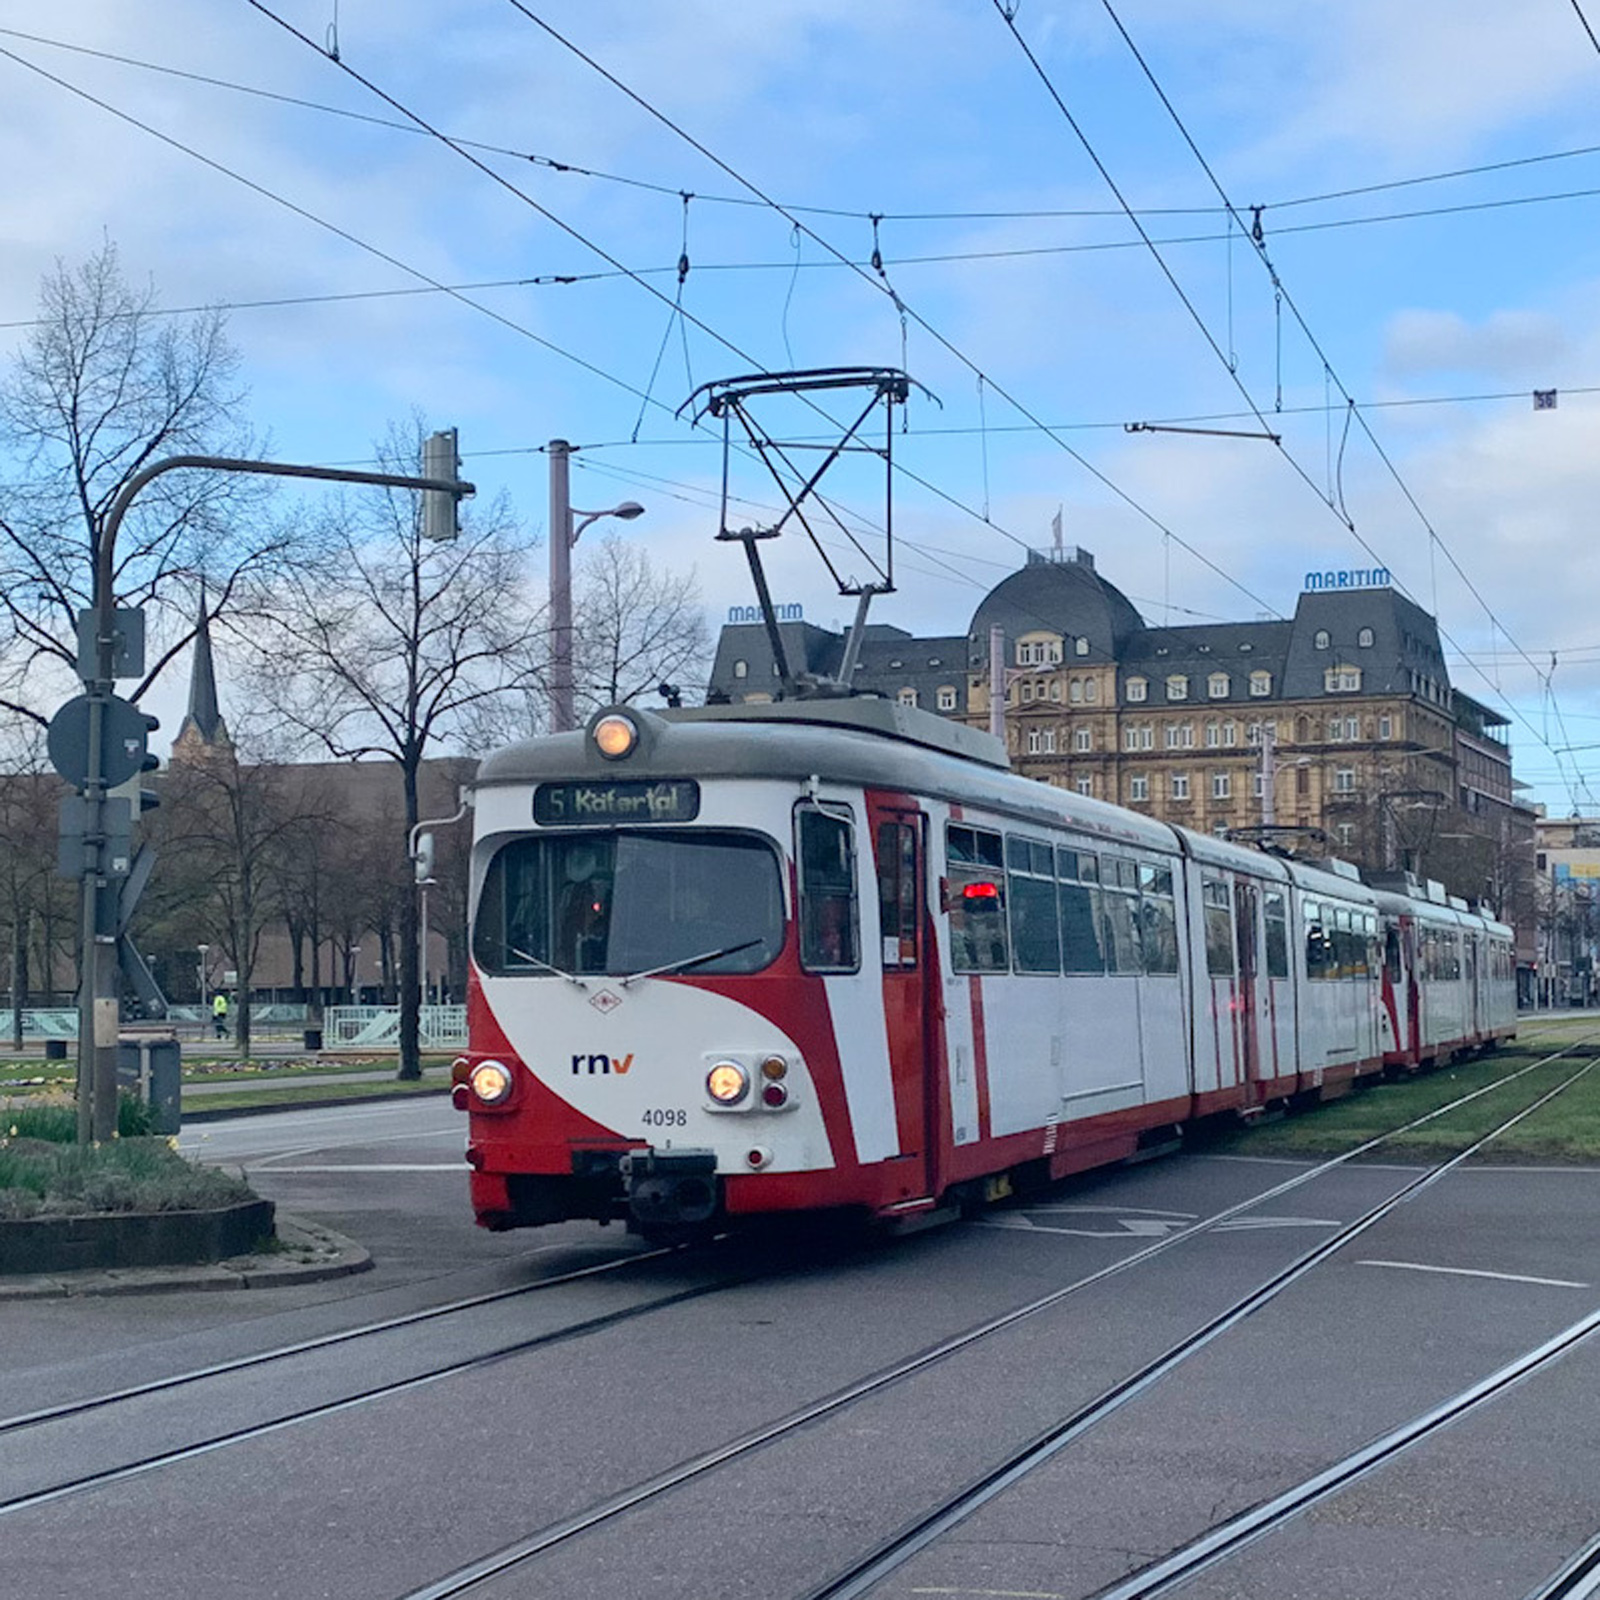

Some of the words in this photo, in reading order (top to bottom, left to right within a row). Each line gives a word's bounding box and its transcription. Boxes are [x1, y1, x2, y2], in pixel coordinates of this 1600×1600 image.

[1304, 567, 1390, 589] MARITIM
[728, 603, 804, 622] MATIM
[575, 786, 679, 813] Käfertal
[571, 1053, 635, 1075] rnv
[641, 1108, 688, 1127] 4098
